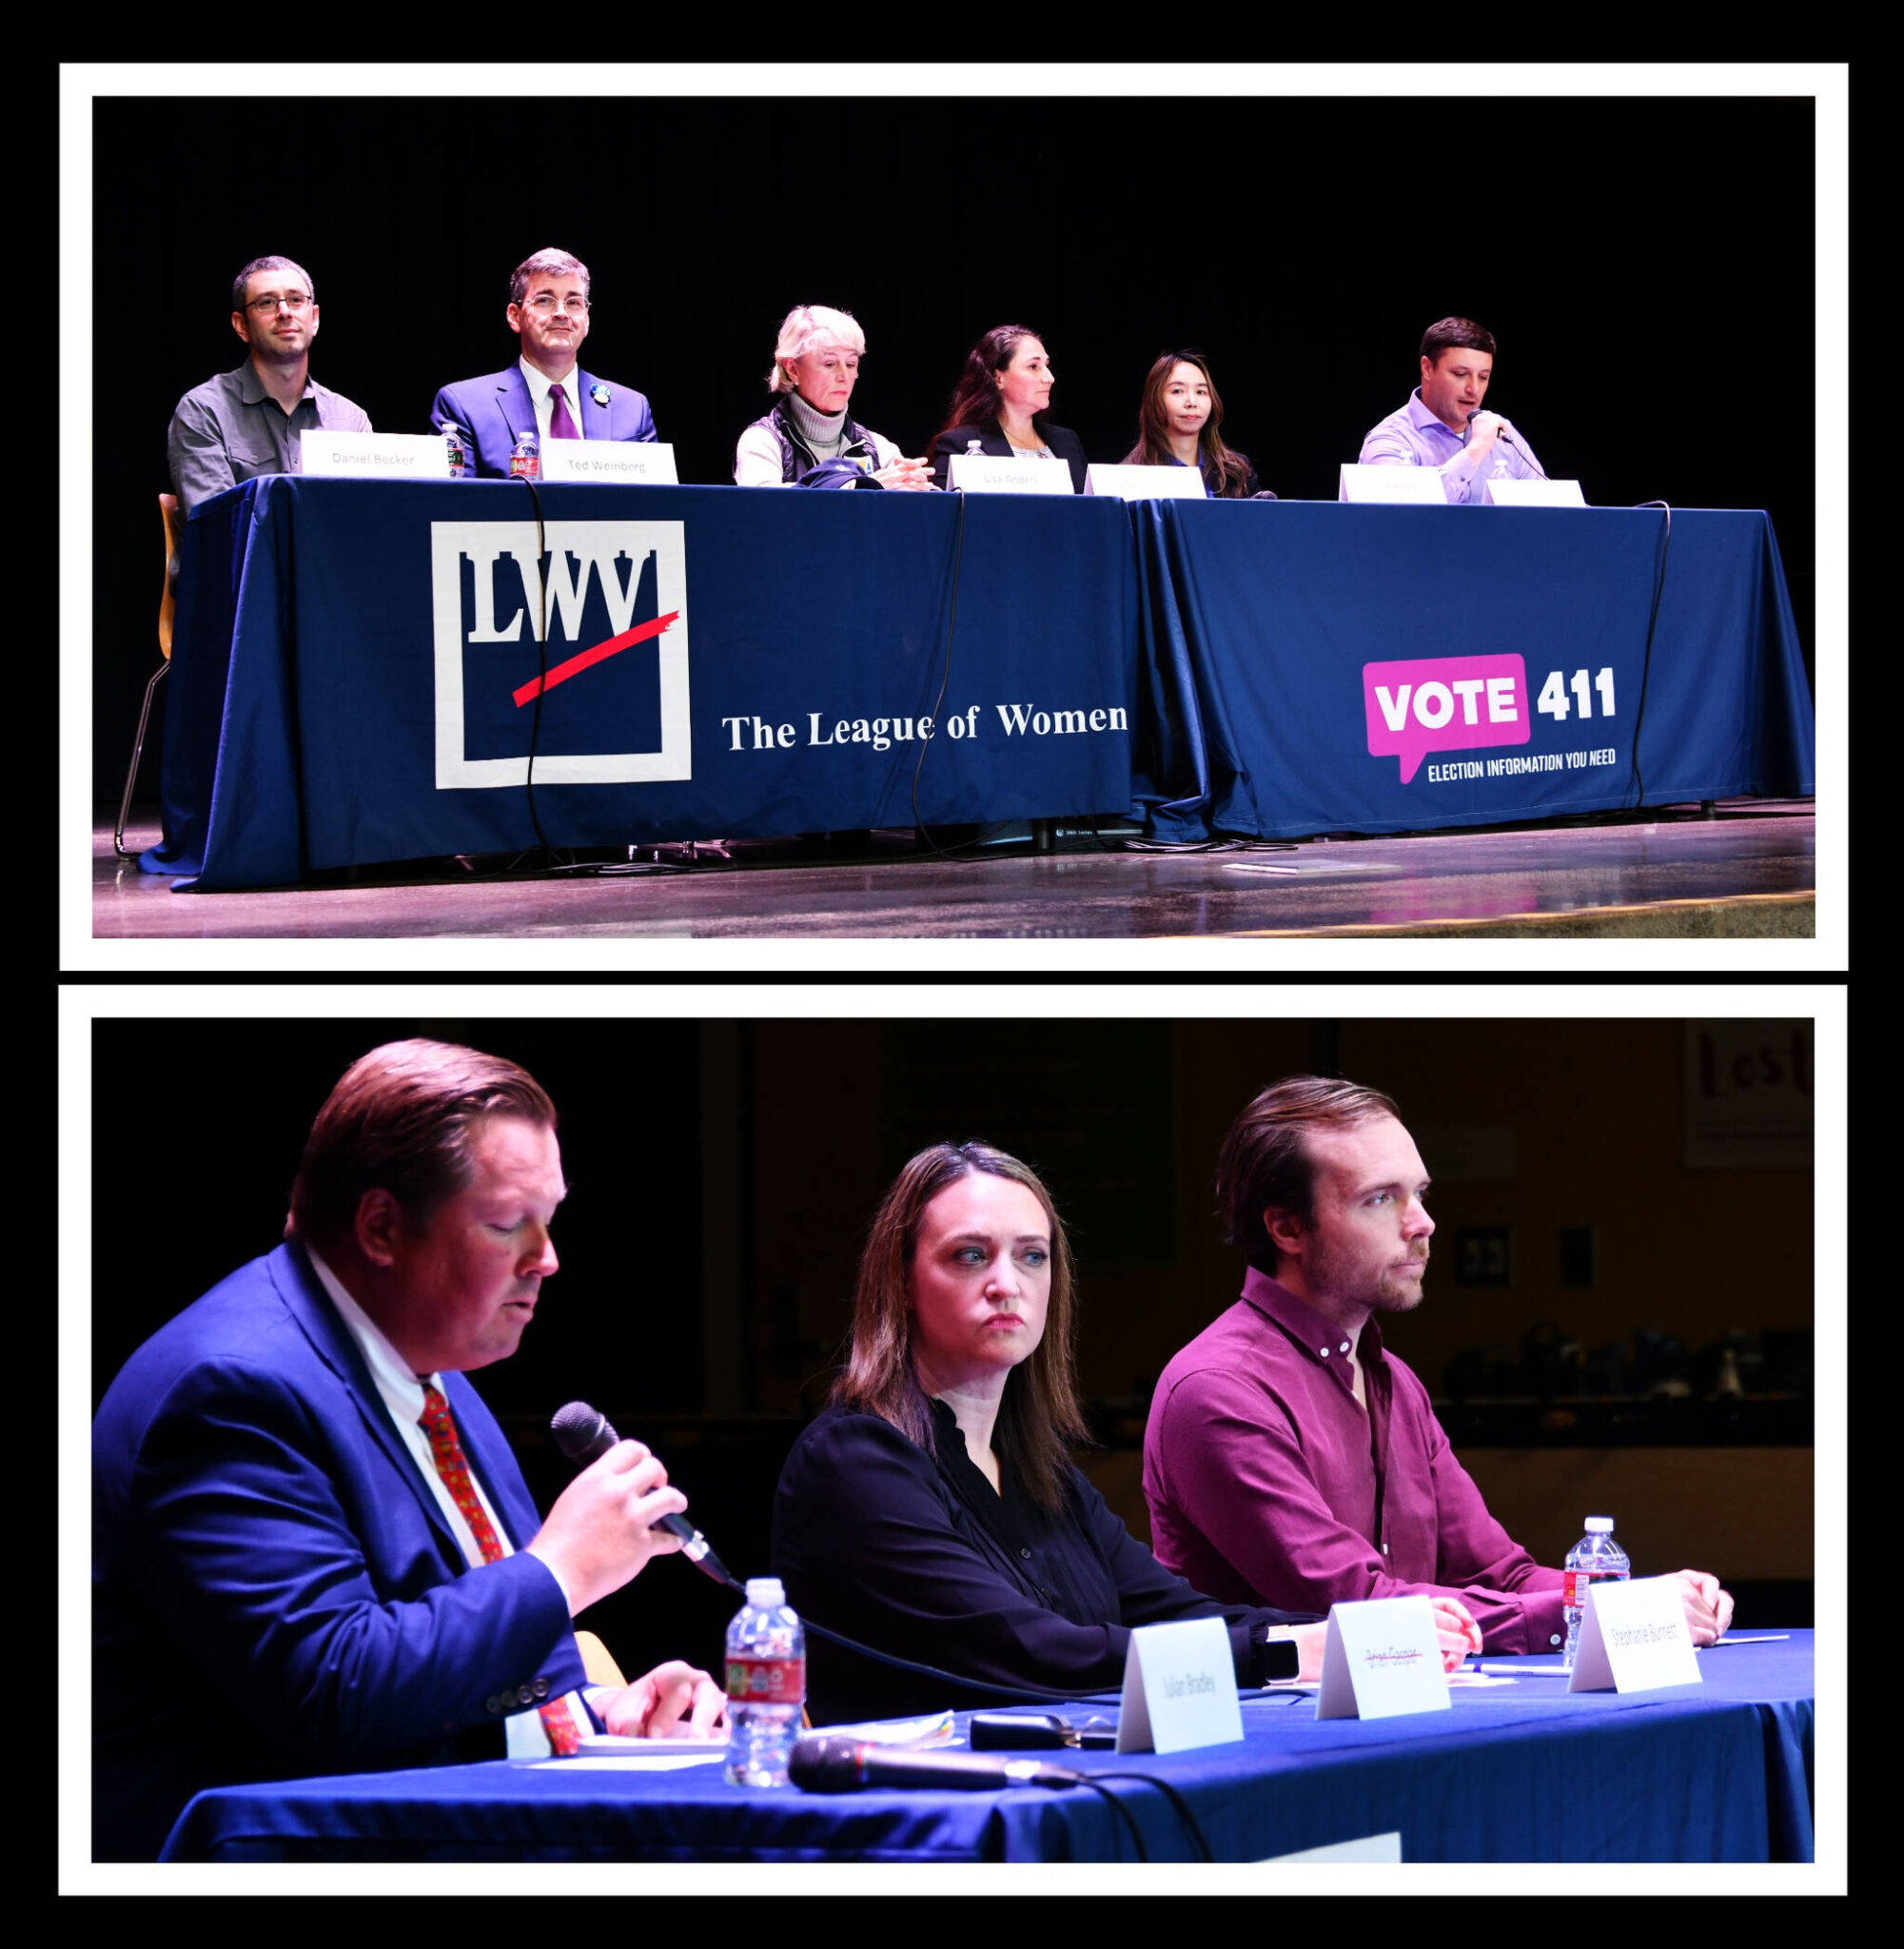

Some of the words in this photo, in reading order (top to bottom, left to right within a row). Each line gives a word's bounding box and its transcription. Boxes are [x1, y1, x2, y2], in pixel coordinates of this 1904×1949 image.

[332, 452, 370, 464] Daniel
[374, 454, 415, 466] Becker
[568, 460, 589, 470] Ted
[592, 461, 647, 474] Weinberg
[467, 549, 657, 642] LWV
[1374, 677, 1519, 731] VOTE
[1537, 667, 1616, 720] 411
[722, 715, 796, 751] The
[806, 712, 935, 752] League
[947, 704, 981, 738] of
[995, 701, 1129, 737] Women
[1428, 760, 1484, 782] ELECTION
[1486, 754, 1563, 778] INFORMATION
[1565, 751, 1588, 770] YOU
[1589, 748, 1616, 767] NEED
